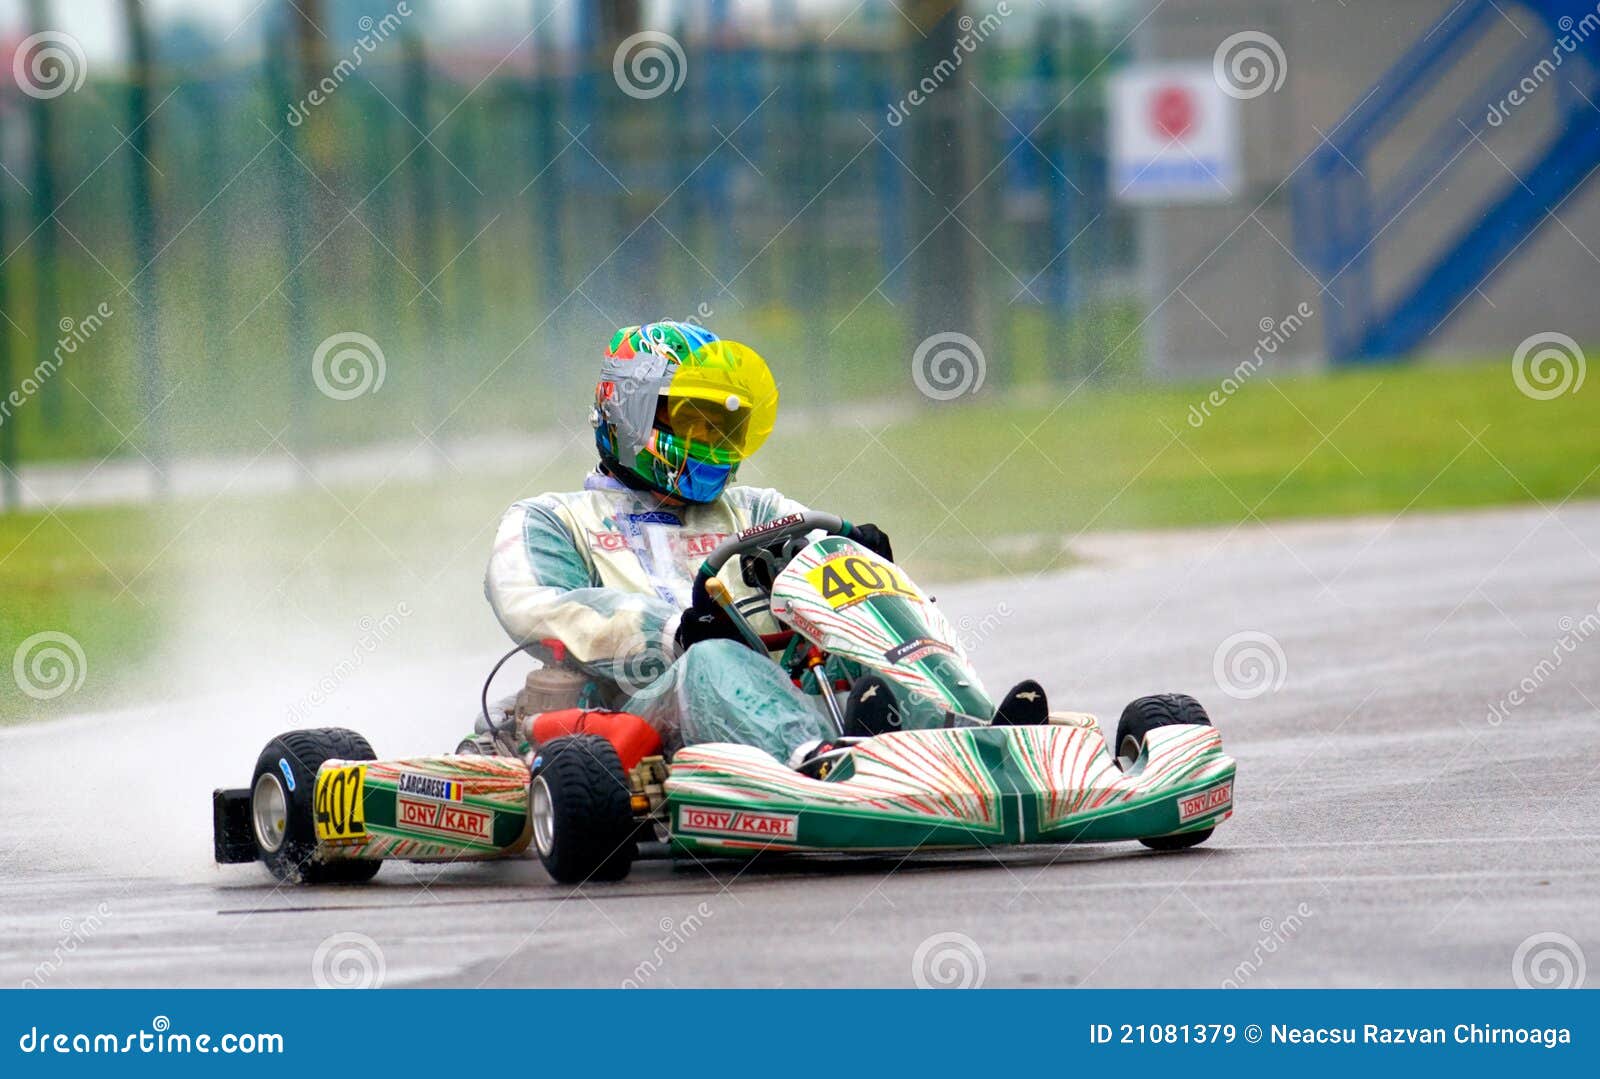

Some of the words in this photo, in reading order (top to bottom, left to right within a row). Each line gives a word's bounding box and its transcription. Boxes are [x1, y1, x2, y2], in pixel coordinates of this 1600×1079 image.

[821, 557, 919, 600] 402
[314, 766, 365, 836] 402
[399, 773, 446, 800] S.ARCARESE
[400, 801, 436, 827] TONY
[446, 808, 490, 835] KART
[683, 808, 732, 831] TONY
[742, 814, 793, 834] KART
